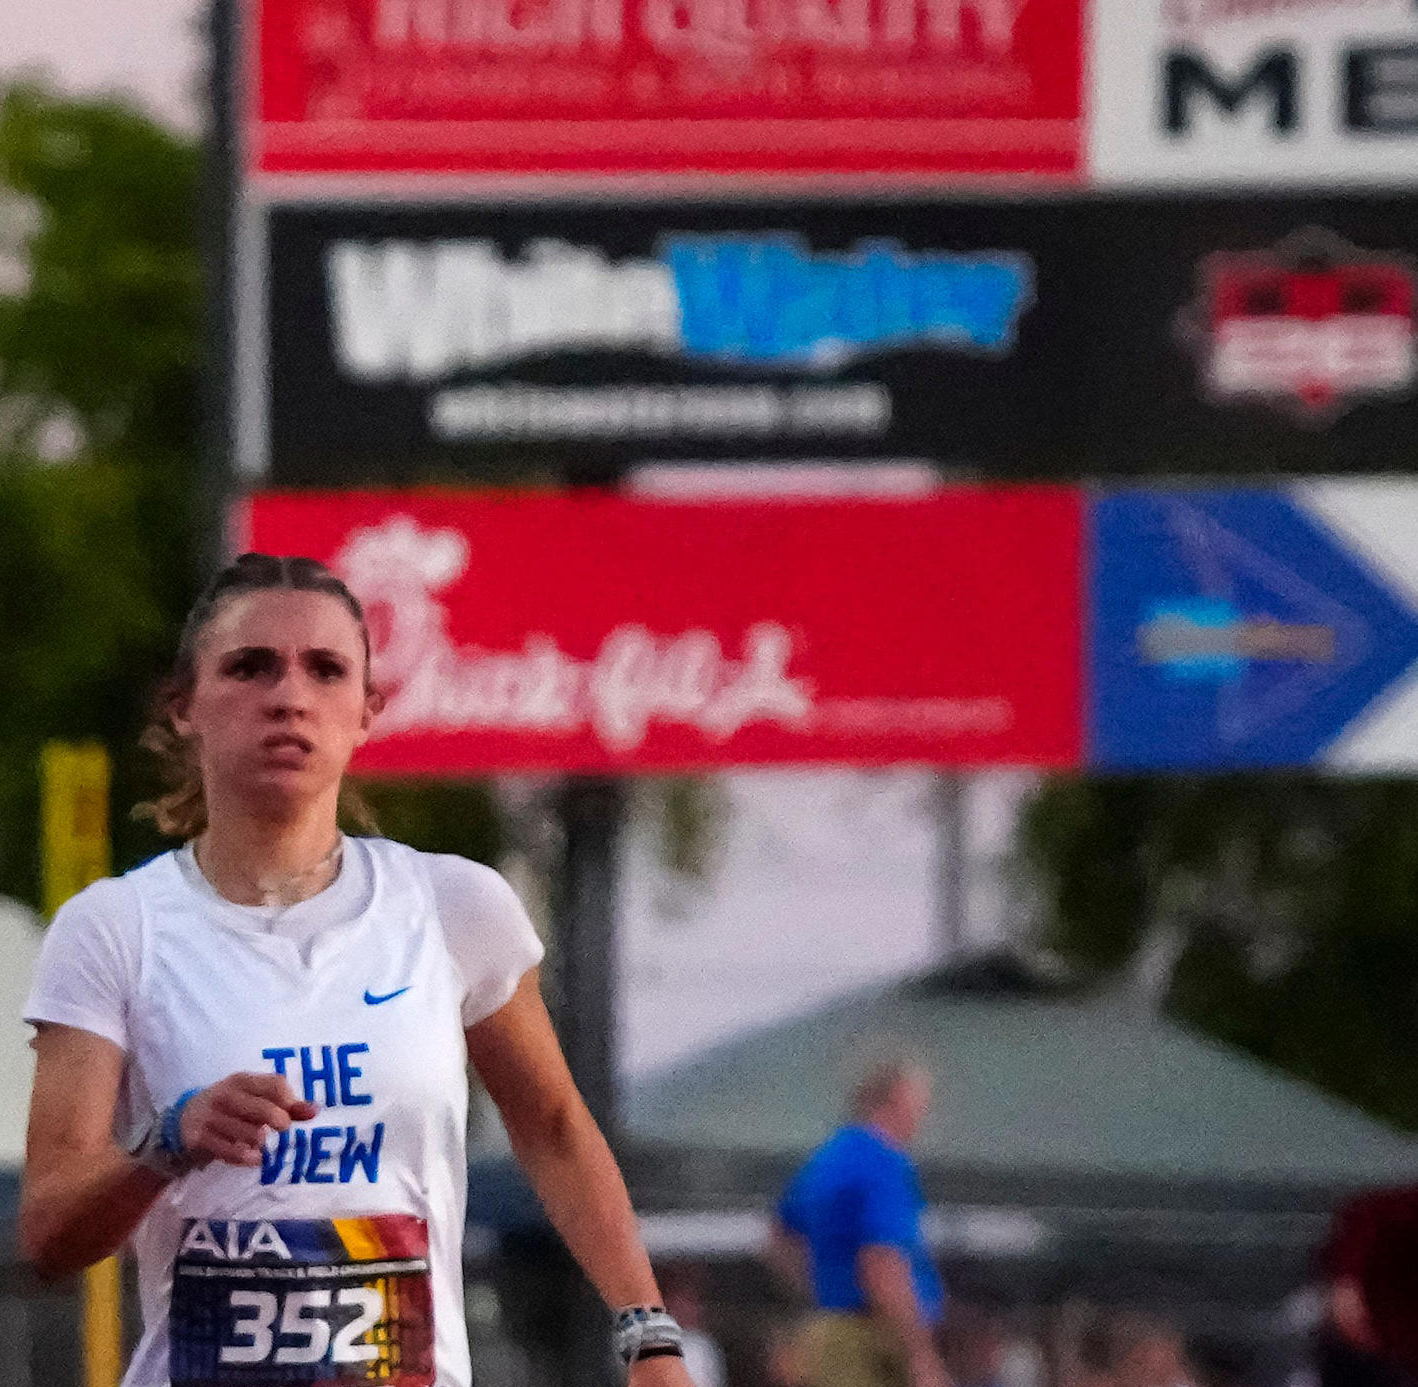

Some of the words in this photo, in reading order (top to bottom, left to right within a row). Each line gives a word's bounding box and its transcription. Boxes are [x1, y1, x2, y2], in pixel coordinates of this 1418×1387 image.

[262, 1042, 372, 1107] THE
[260, 1122, 385, 1185] VIEW
[178, 1218, 293, 1260] AIA
[217, 1287, 385, 1363] 352
